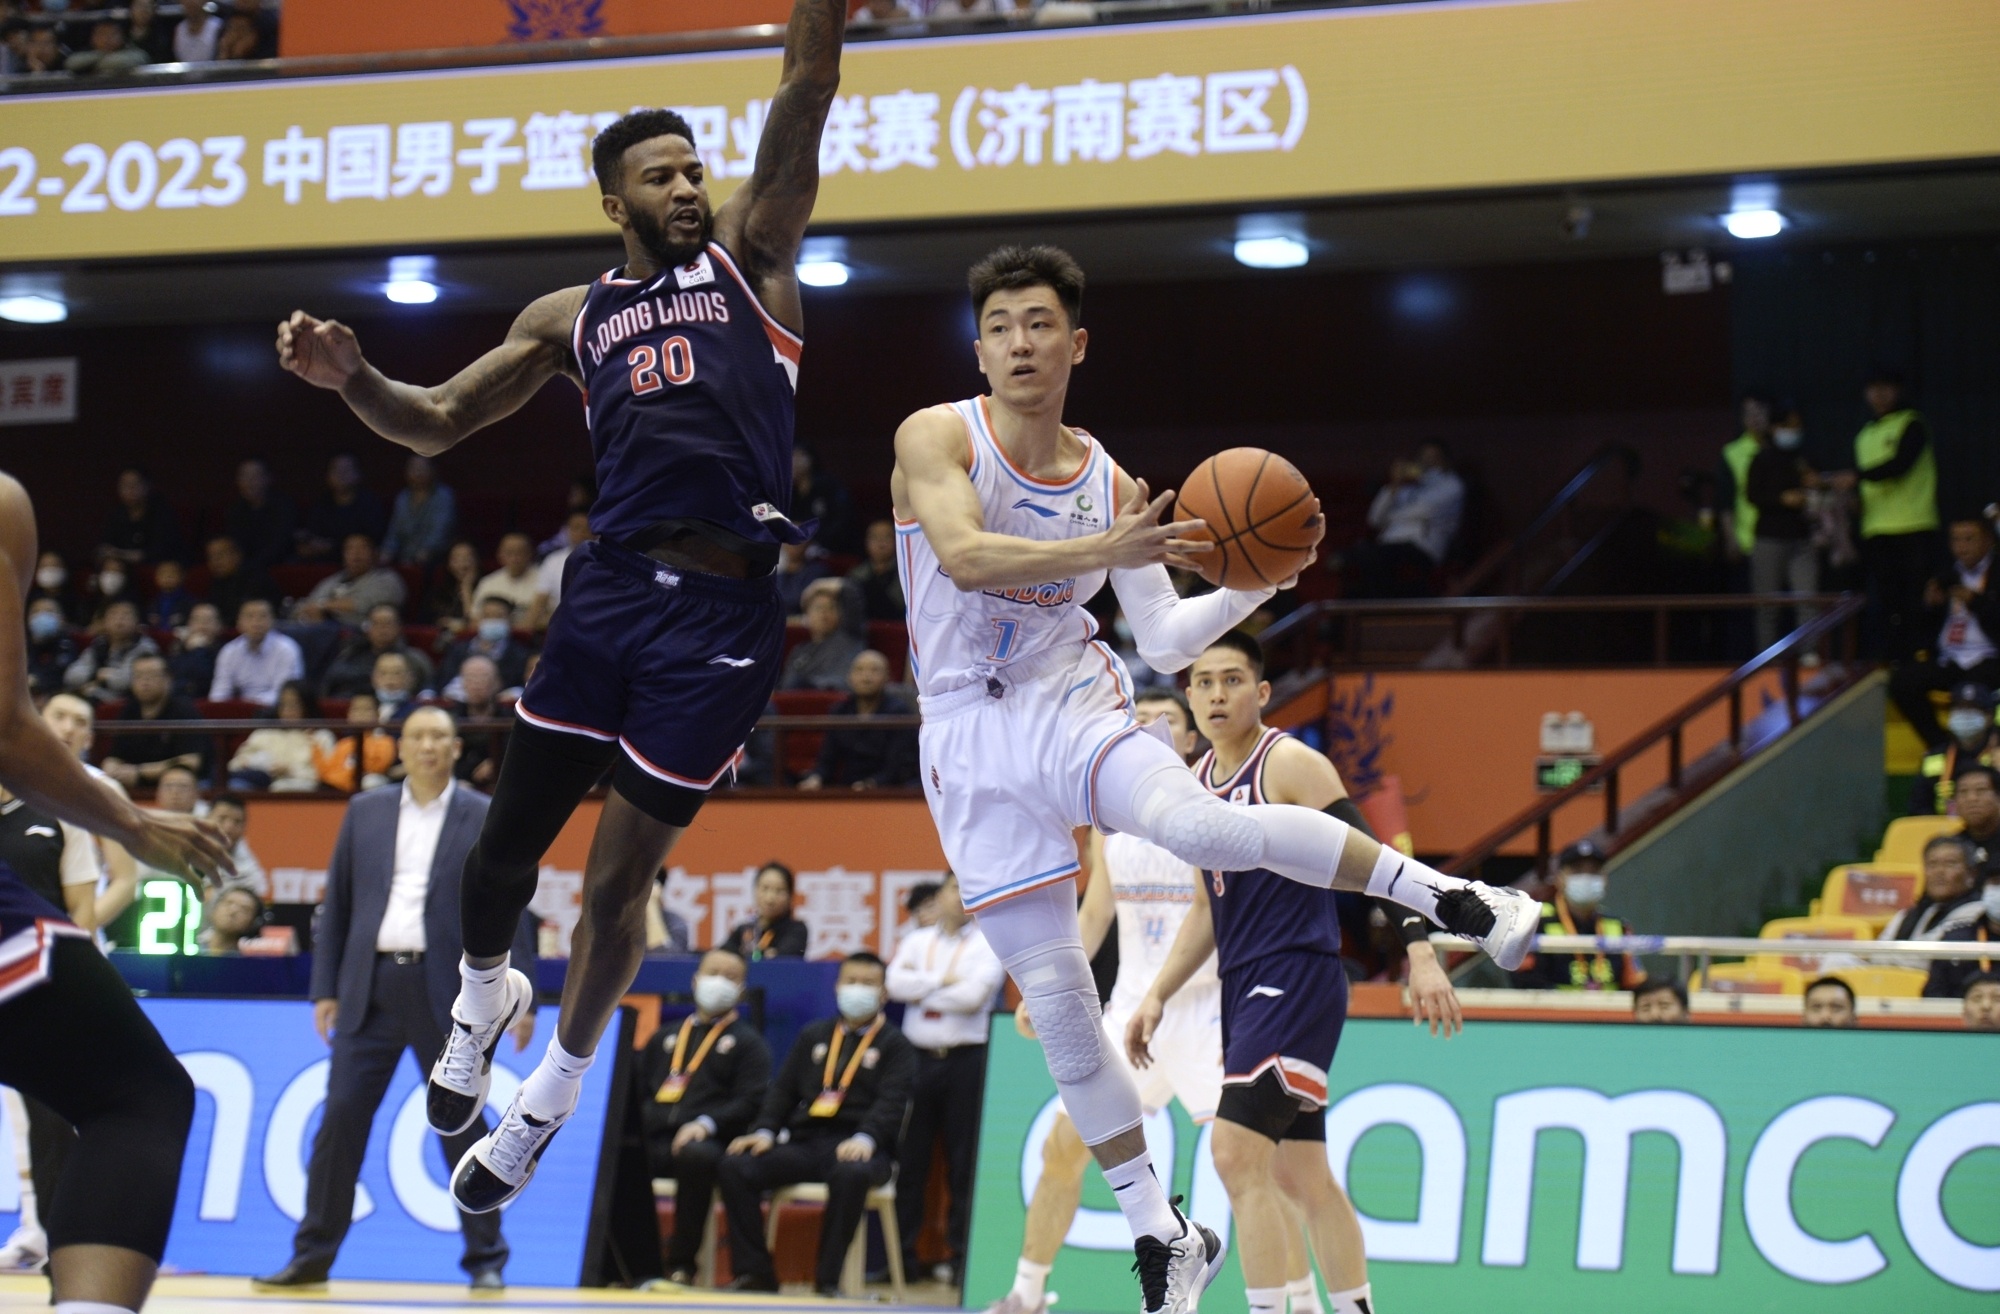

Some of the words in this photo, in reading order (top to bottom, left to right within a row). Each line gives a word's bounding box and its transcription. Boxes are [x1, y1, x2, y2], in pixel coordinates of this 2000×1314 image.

[587, 300, 653, 367] LOONG
[656, 291, 730, 325] LIONS
[627, 335, 695, 396] 20
[986, 617, 1020, 663] 1
